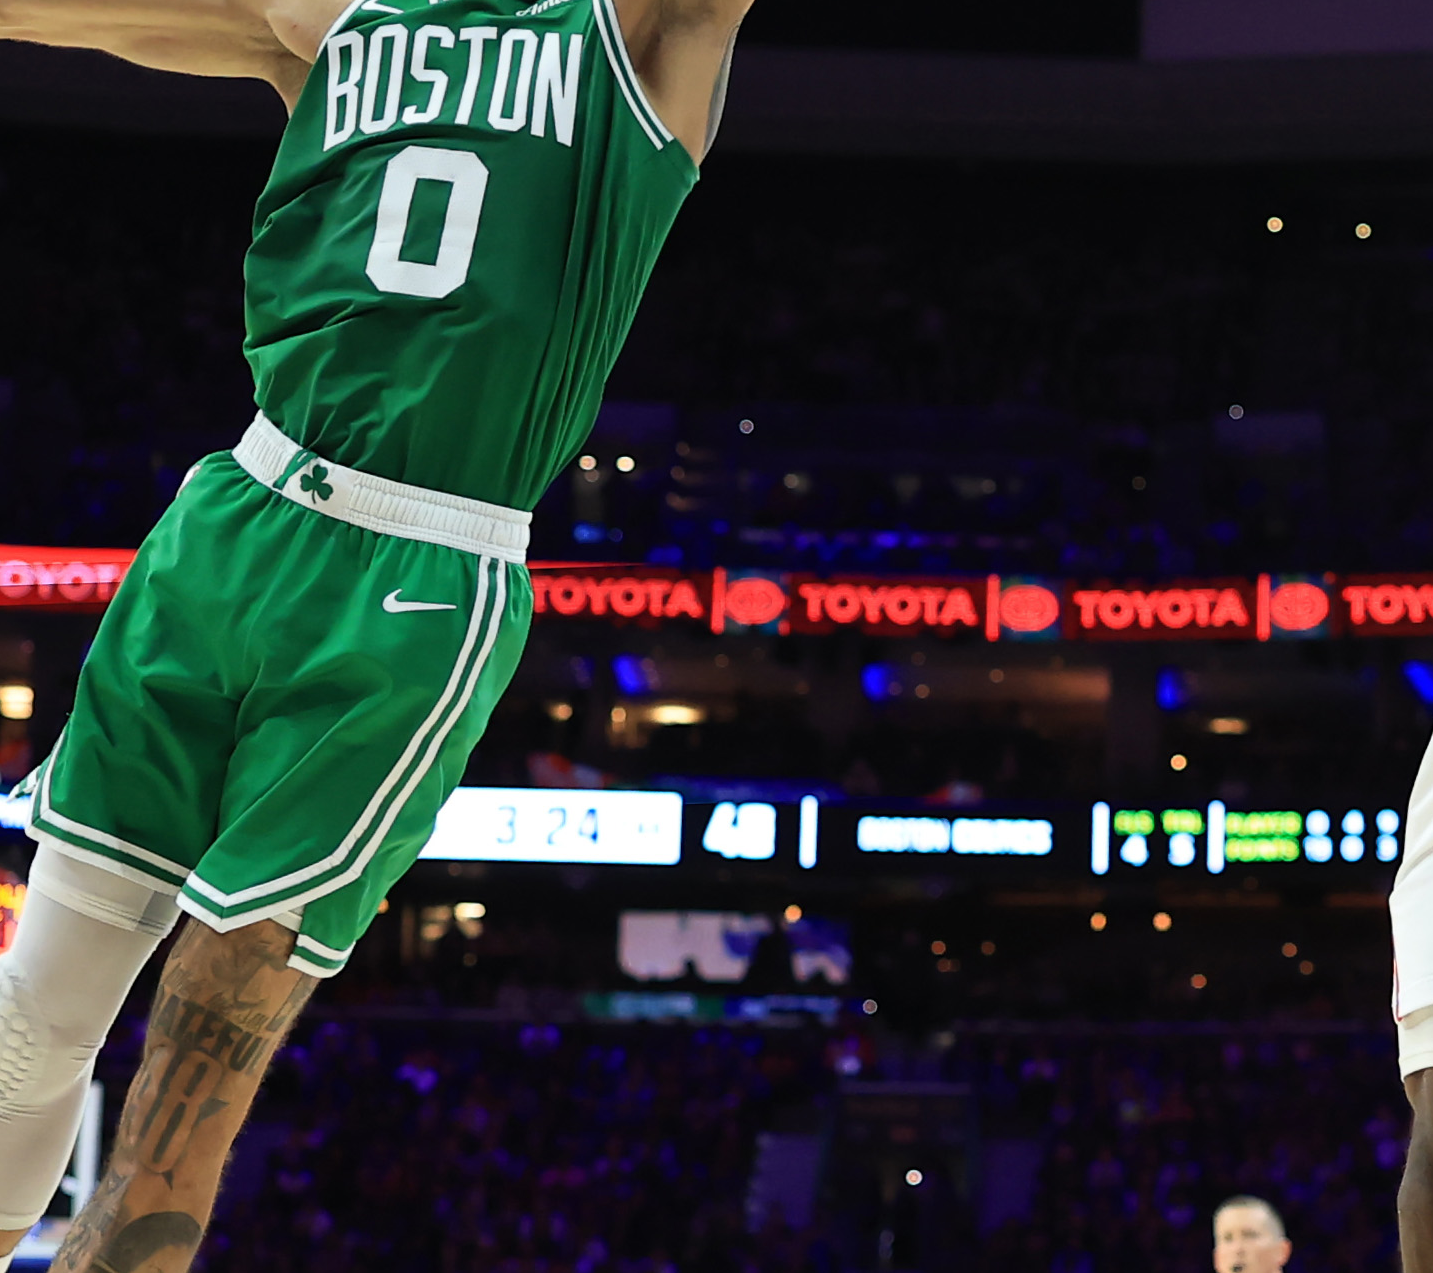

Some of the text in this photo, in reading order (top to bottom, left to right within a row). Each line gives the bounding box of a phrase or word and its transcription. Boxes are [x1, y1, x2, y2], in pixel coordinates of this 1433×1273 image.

[323, 24, 584, 152] BOSTON
[365, 145, 489, 299] 0
[530, 575, 704, 619] TOYOTA
[798, 582, 979, 627] TOYOTA
[1073, 587, 1250, 630] TOYOTA
[496, 805, 600, 845] 324
